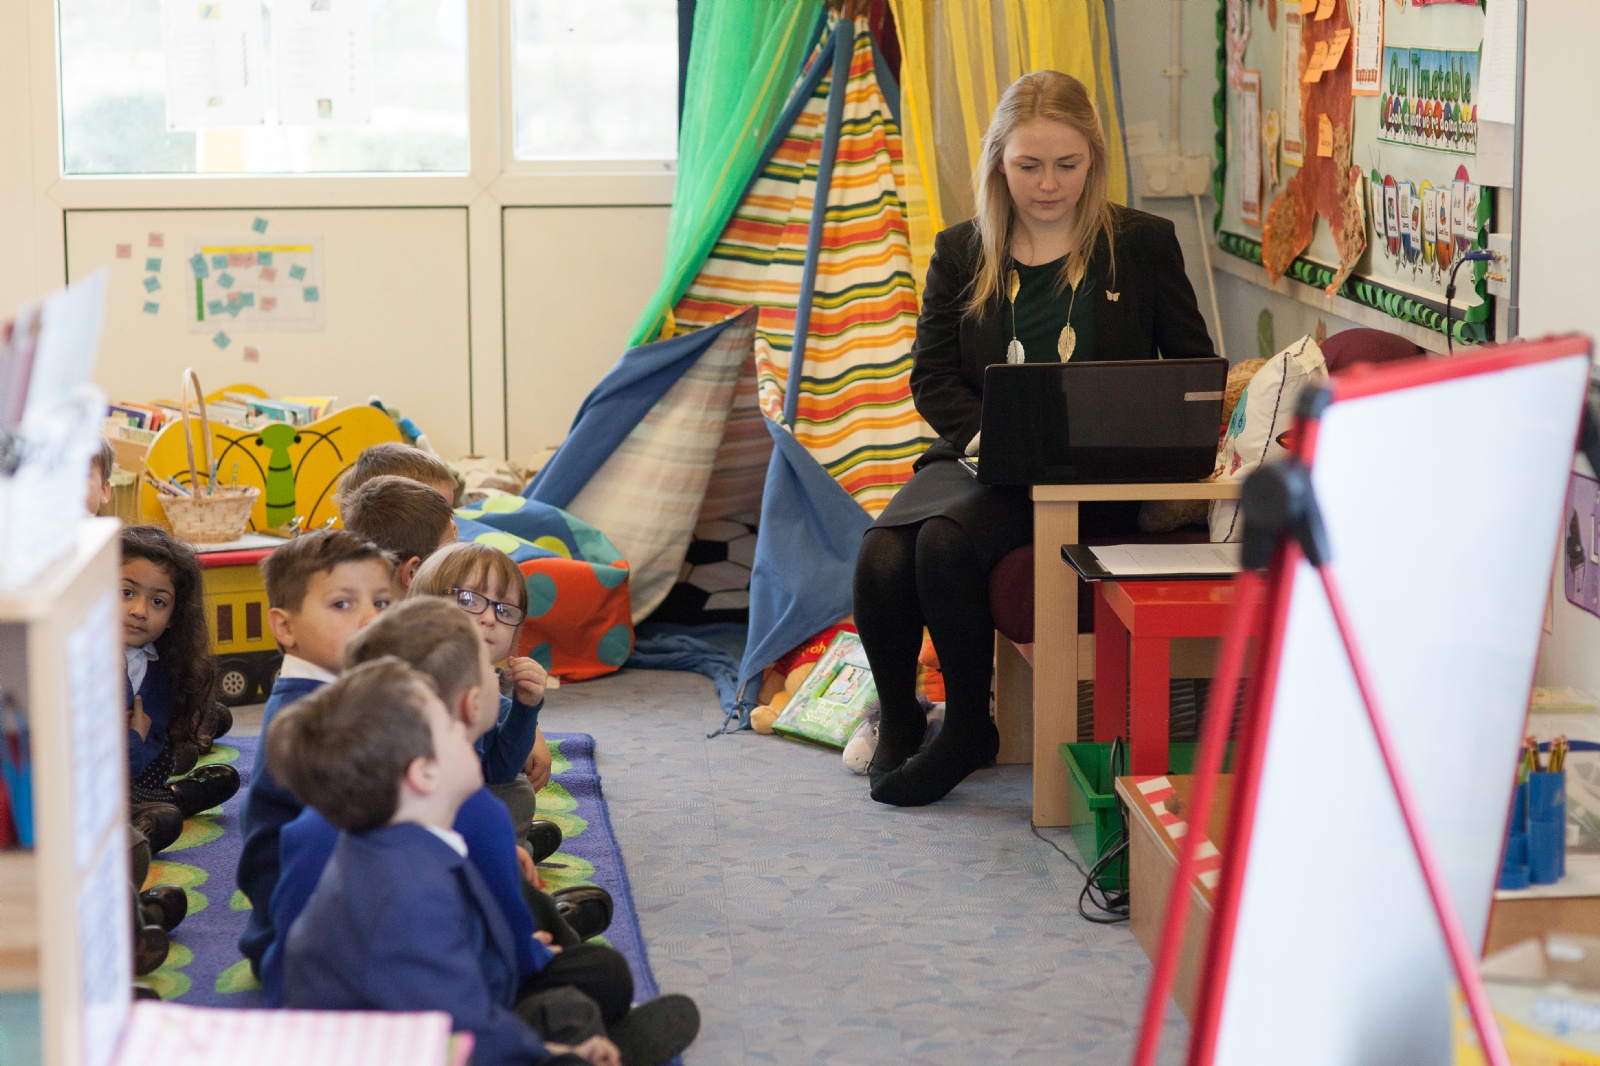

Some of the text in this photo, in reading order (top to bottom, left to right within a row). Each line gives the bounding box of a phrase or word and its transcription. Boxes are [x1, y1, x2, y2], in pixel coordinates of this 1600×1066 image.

[1389, 52, 1471, 104] Our Timetable
[1388, 103, 1402, 124] Look
[1422, 109, 1439, 130] we're
[1440, 111, 1457, 142] doing
[1459, 110, 1477, 145] today
[801, 708, 832, 728] Stories
[815, 701, 835, 717] Pooh
